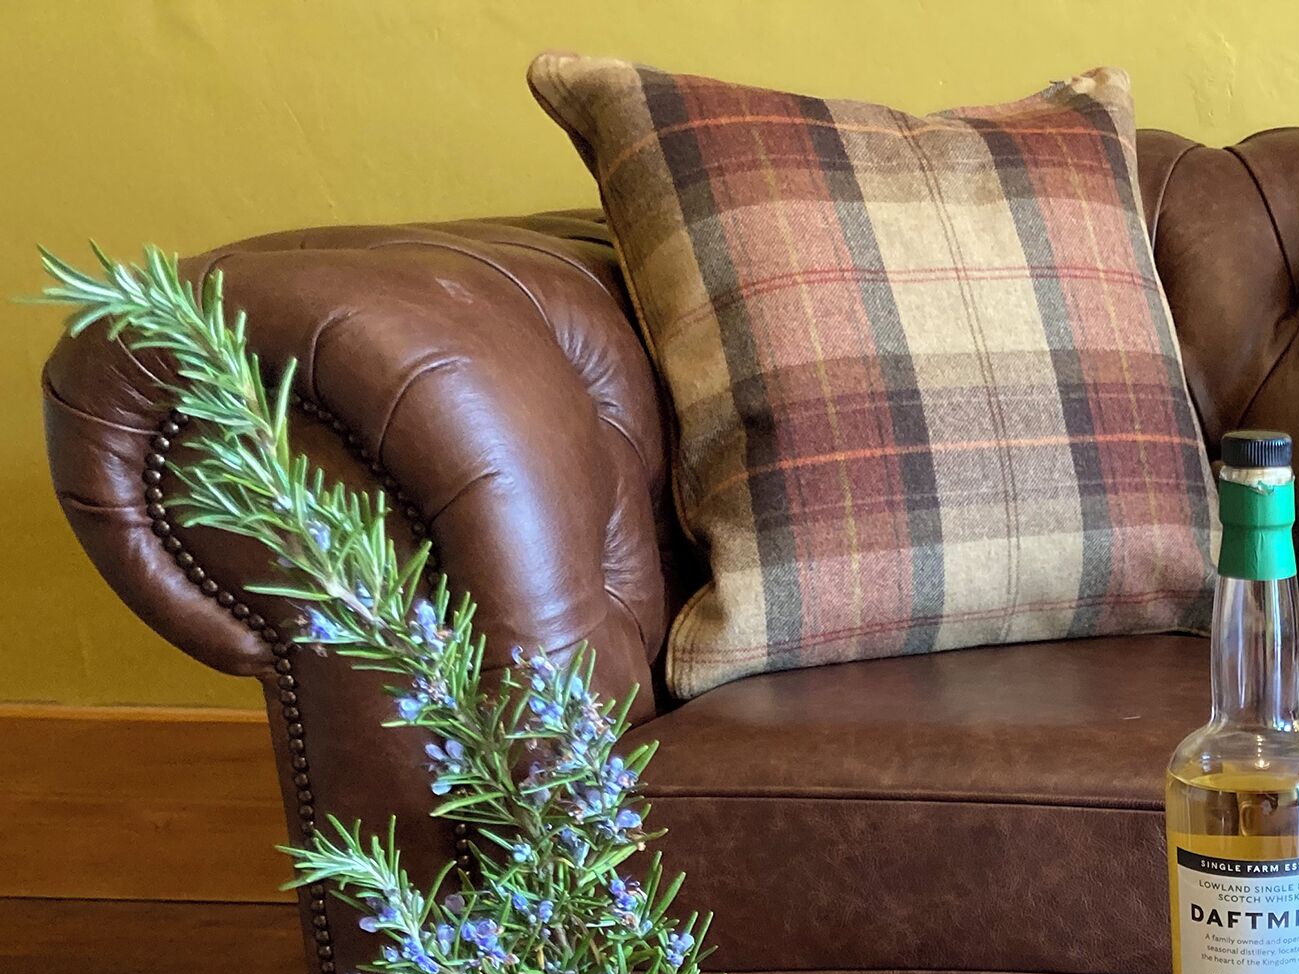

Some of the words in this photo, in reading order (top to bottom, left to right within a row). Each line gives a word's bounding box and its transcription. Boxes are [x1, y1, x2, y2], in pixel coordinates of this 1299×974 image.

[1200, 859, 1241, 873] SINGLE
[1247, 864, 1279, 873] FARM
[1199, 879, 1251, 893] LOWLAND
[1254, 884, 1294, 893] SINGLE
[1218, 893, 1261, 904] SCOTCH
[1211, 934, 1235, 945] family
[1237, 935, 1264, 945] owned
[1266, 935, 1281, 945] and
[1207, 944, 1239, 956] seasonal
[1201, 952, 1213, 962] the
[1214, 954, 1235, 965] heart
[1236, 957, 1246, 966] of
[1246, 957, 1261, 966] the
[1262, 957, 1297, 968] Kingdom
